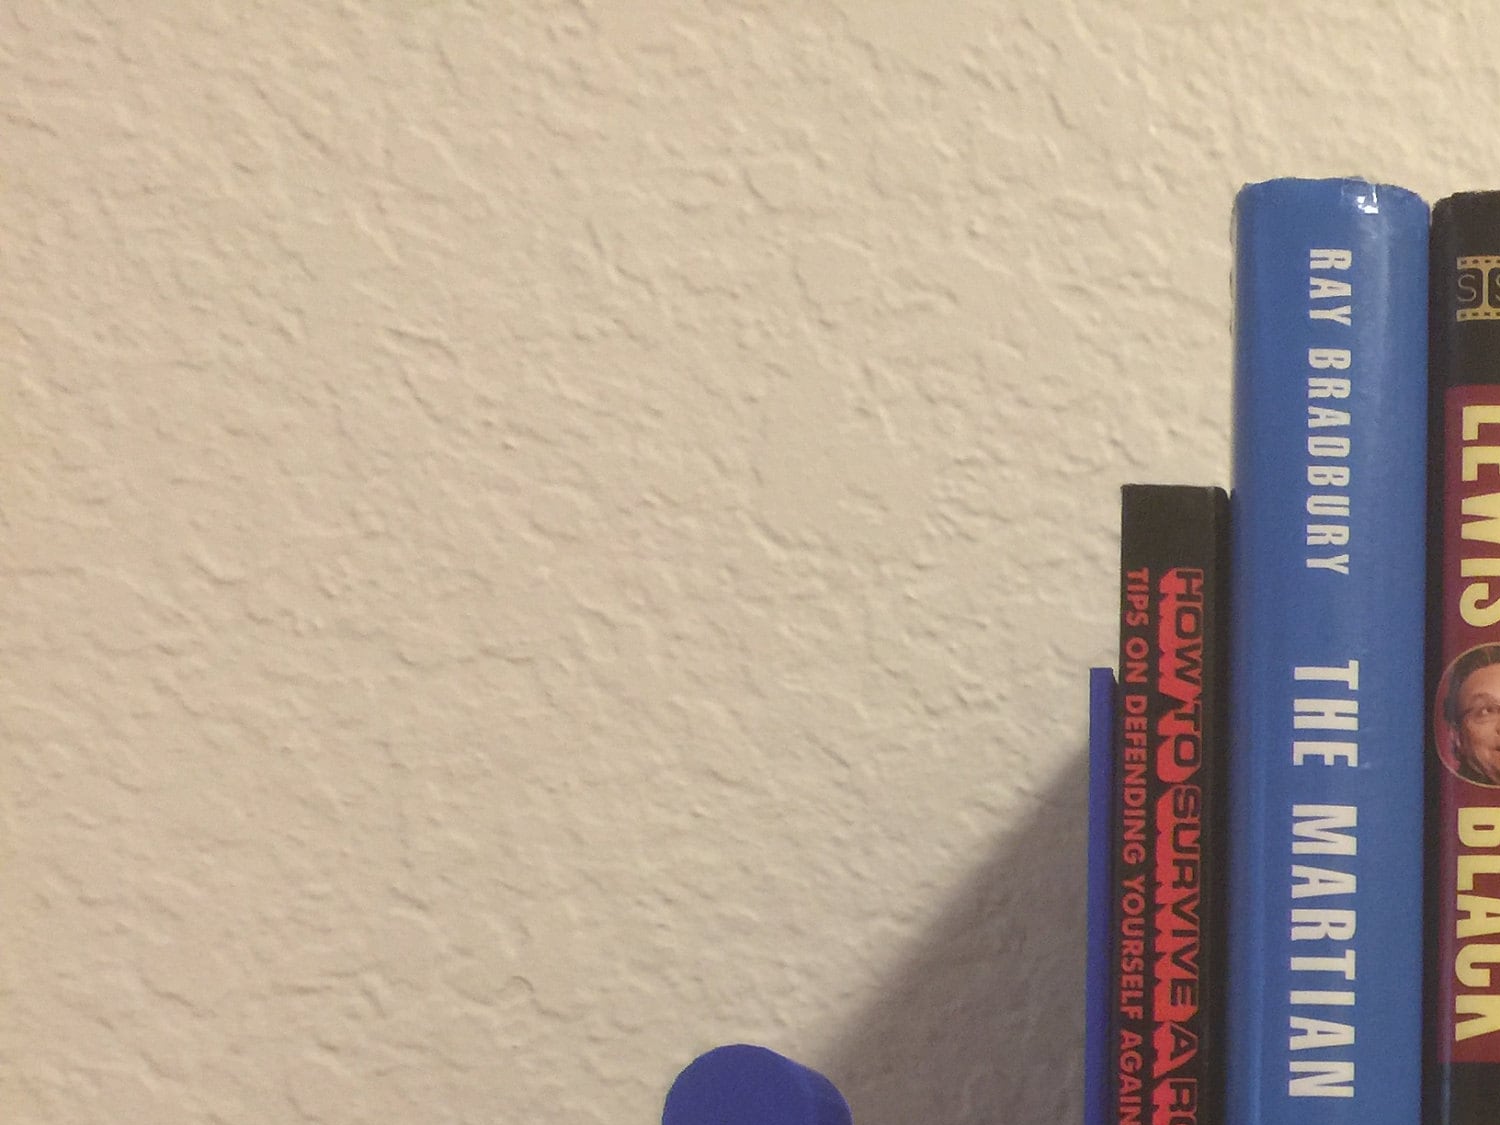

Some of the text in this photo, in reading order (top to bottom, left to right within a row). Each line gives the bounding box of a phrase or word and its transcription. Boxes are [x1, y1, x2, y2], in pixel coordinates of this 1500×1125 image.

[1306, 248, 1352, 575] RAY BRADBURY
[1124, 567, 1149, 626] TIPS
[1124, 637, 1148, 683] ON
[1157, 566, 1204, 698] HOW
[1156, 699, 1202, 783] TO
[1293, 660, 1359, 767] THE
[1122, 696, 1146, 864] DEFENDING
[1119, 875, 1145, 1019] YOURSELF
[1152, 784, 1201, 1022] SURVIVE
[1289, 804, 1358, 1098] MARTIAN
[1151, 1021, 1199, 1078] A
